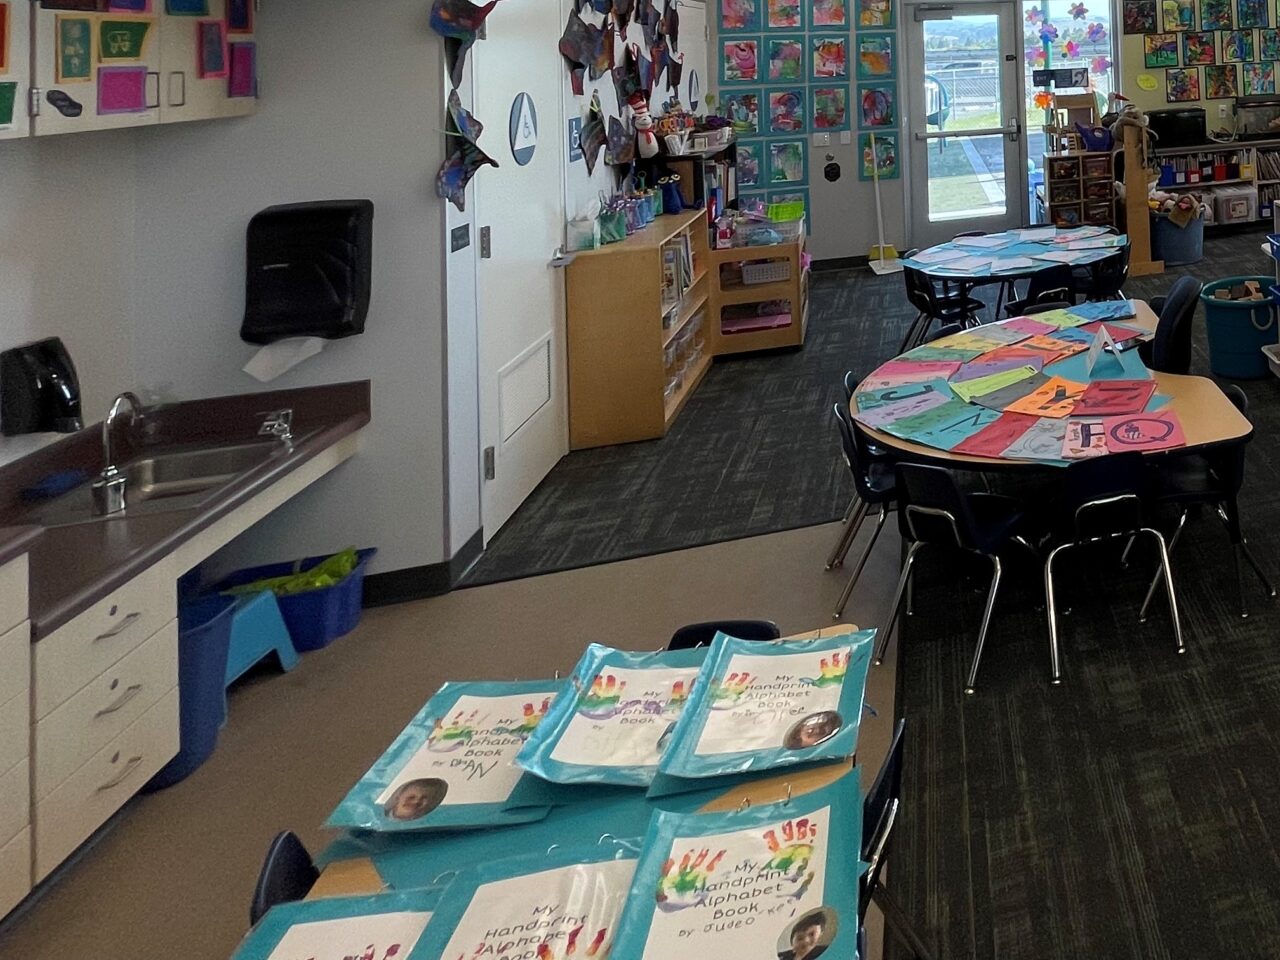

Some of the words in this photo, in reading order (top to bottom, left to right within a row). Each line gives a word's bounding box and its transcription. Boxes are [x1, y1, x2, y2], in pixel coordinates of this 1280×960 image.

[464, 749, 504, 758] Book
[734, 861, 758, 874] My
[694, 867, 790, 894] Handprint
[694, 883, 785, 909] Alphabet
[532, 904, 561, 916] My
[713, 902, 759, 920] Book
[485, 914, 590, 940] Handprint
